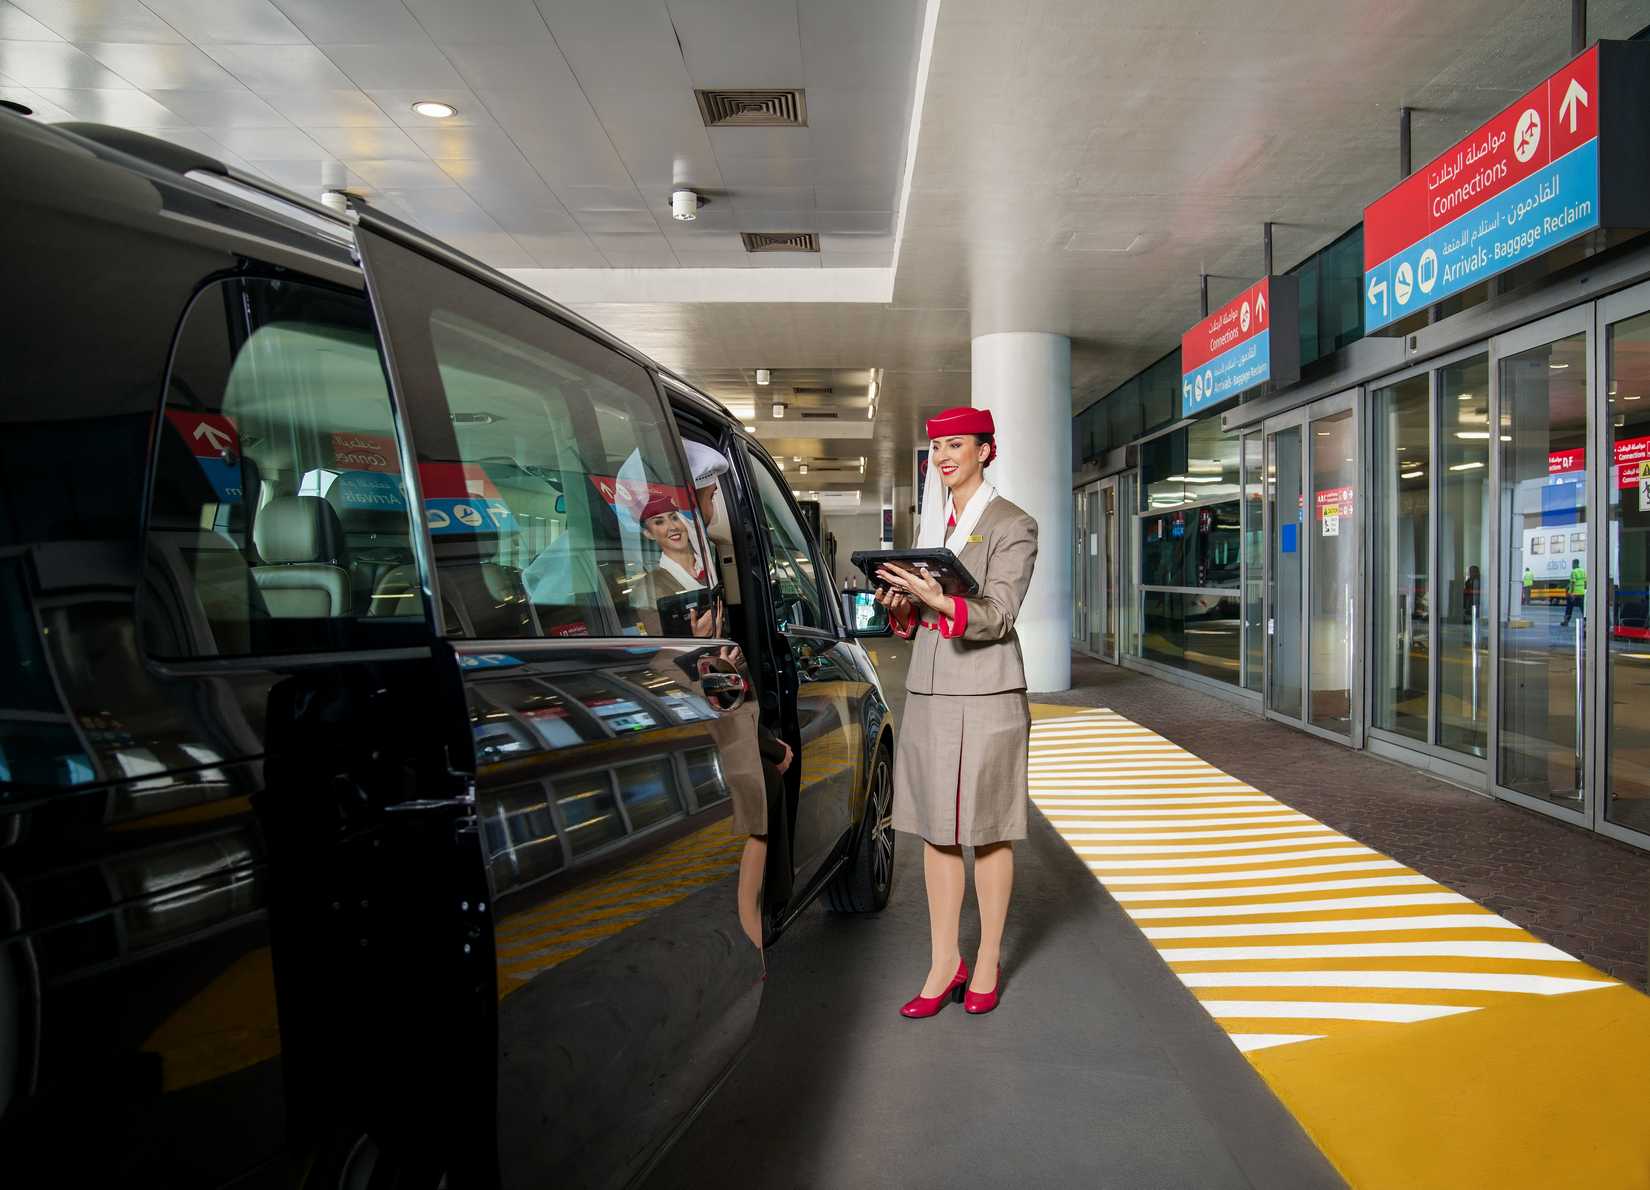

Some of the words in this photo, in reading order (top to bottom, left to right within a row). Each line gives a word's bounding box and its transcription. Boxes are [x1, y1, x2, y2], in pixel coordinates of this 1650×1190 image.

[1465, 130, 1506, 165] مواصلة
[1429, 152, 1463, 190] الرحلات
[1433, 159, 1507, 217] Connections
[1507, 174, 1560, 225] القادمون
[1442, 247, 1487, 285] Arrivals
[1494, 225, 1541, 261] Baggage
[1543, 201, 1591, 235] Reclaim
[1471, 211, 1500, 246] استلام
[1209, 326, 1239, 352] Connections
